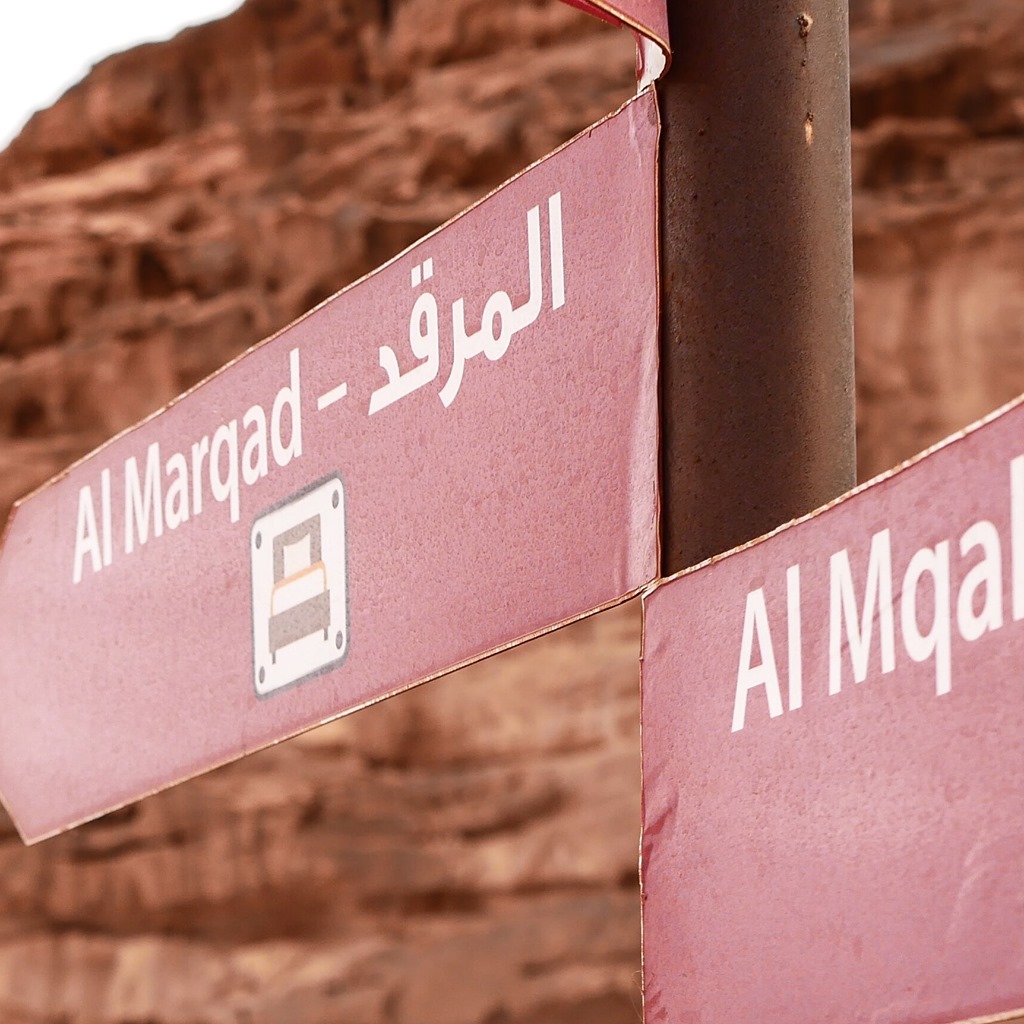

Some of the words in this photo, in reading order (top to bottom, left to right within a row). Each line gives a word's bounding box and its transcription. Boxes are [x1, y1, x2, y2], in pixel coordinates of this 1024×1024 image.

[72, 468, 113, 585] Al
[124, 347, 303, 555] Marqad
[368, 191, 565, 416] المرقد
[731, 564, 803, 733] Al
